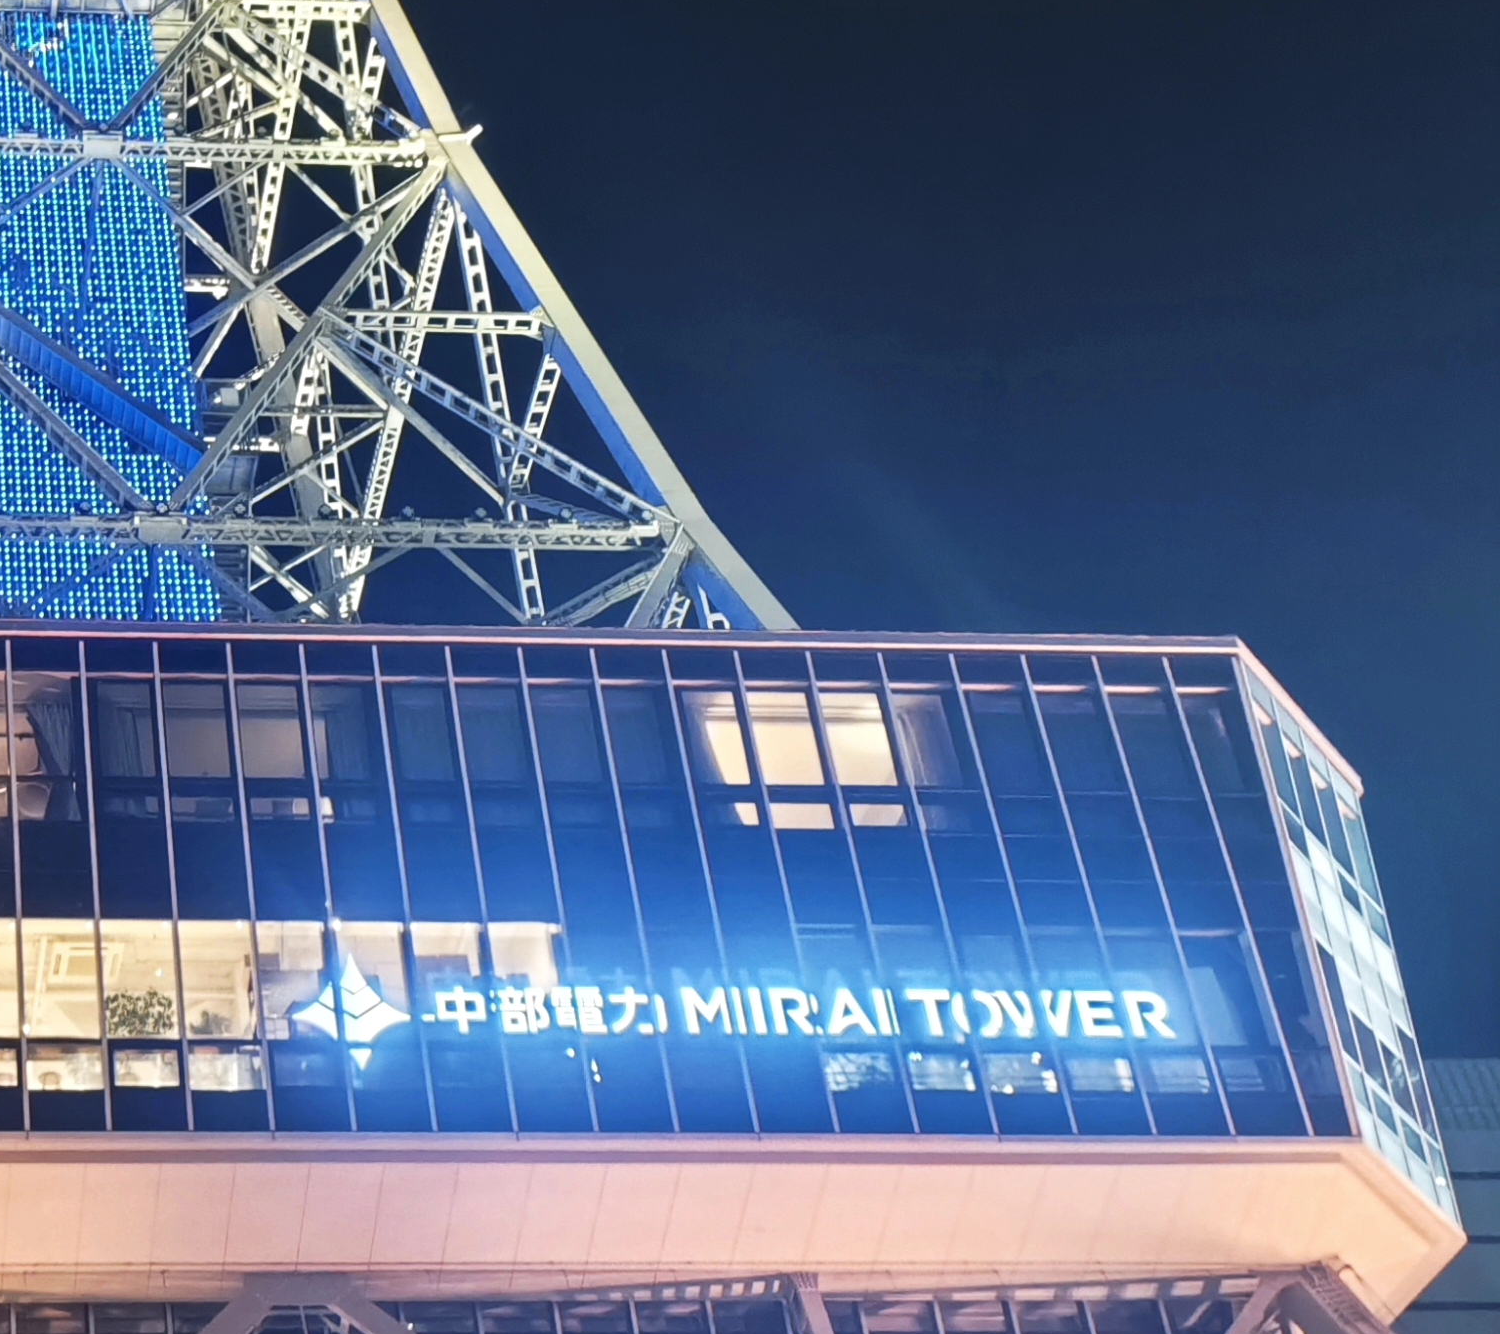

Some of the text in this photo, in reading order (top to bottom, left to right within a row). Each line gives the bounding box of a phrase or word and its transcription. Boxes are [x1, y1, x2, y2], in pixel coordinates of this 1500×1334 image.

[434, 985, 1177, 1039] 中部電力 MIRAI TOWER
